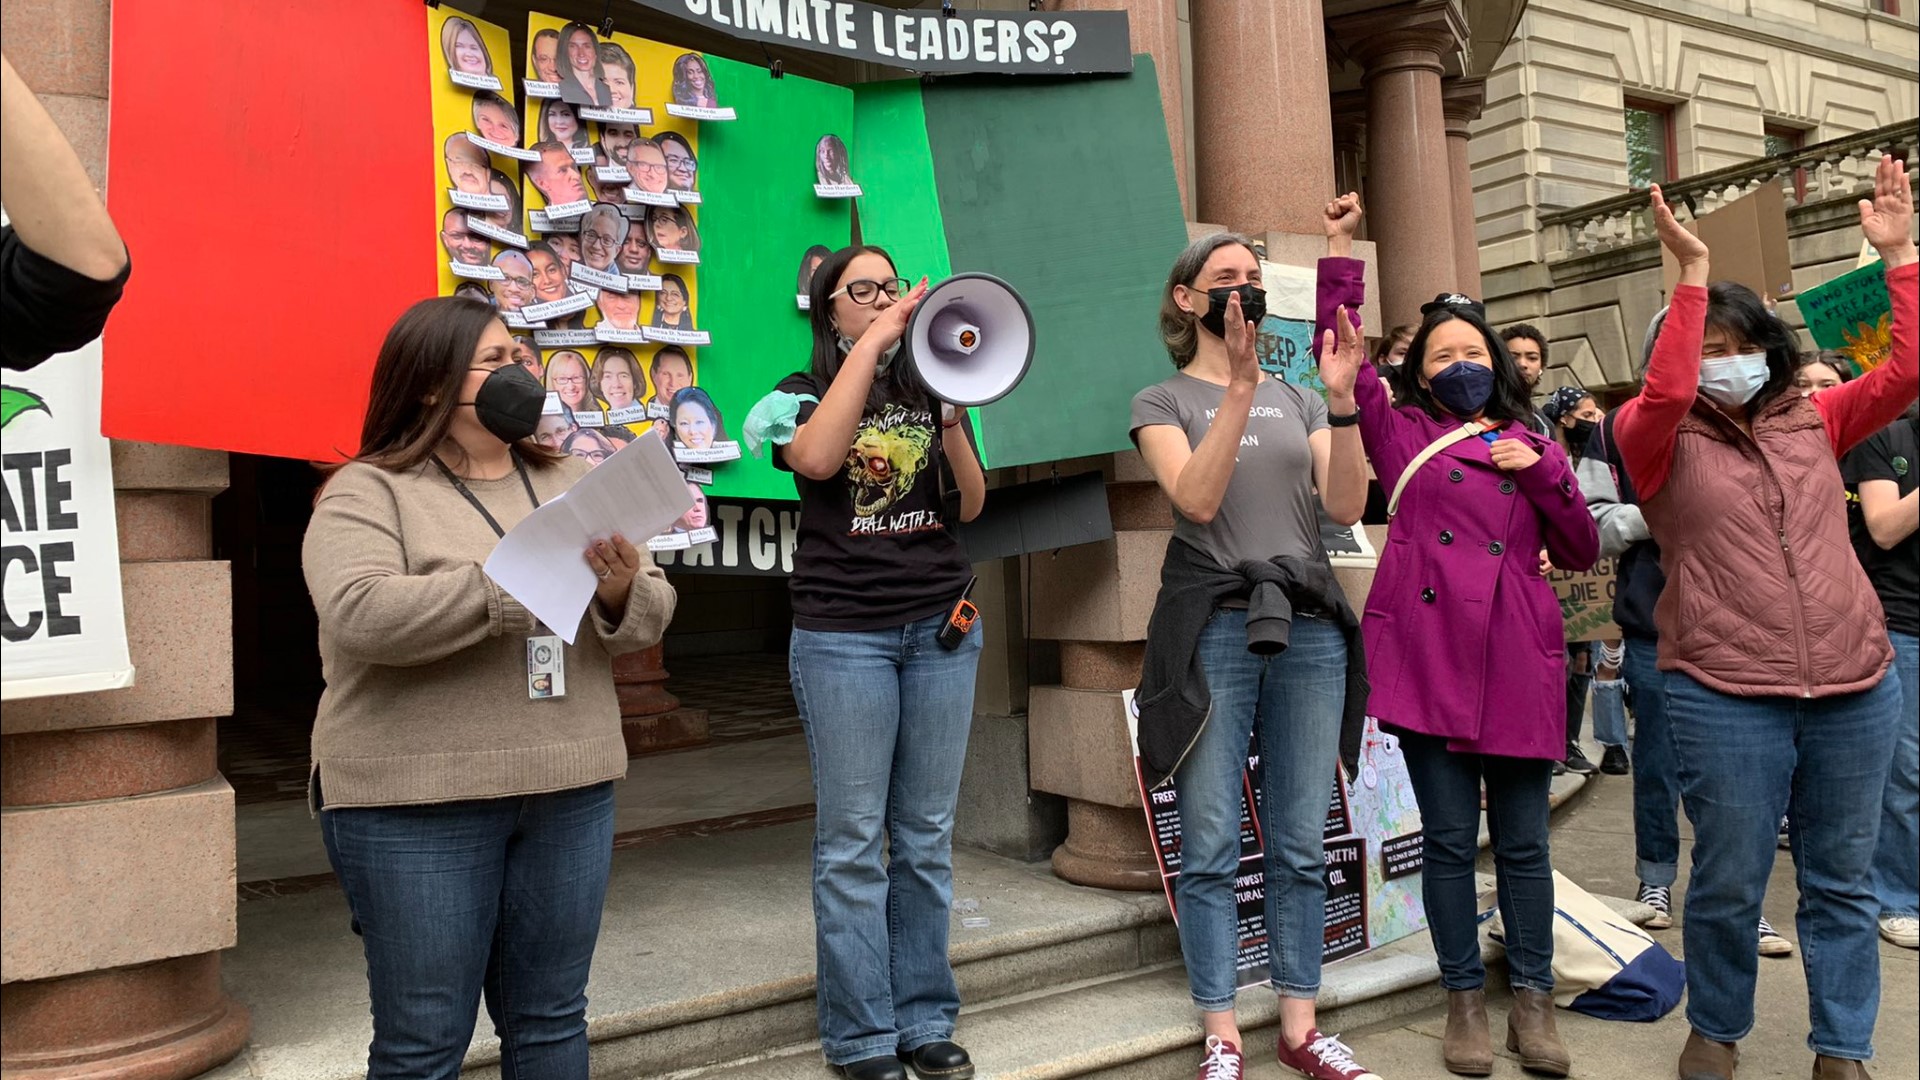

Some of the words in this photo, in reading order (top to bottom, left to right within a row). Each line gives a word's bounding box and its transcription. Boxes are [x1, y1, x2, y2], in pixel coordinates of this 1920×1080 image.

[872, 11, 1077, 65] LEADERS?
[526, 82, 551, 90] Michael
[548, 205, 560, 213] Ted
[561, 201, 588, 211] Wheeler
[580, 267, 594, 275] Tina
[595, 271, 613, 281] Kotek
[1257, 334, 1296, 368] EEP
[608, 411, 625, 419] Mary
[626, 408, 643, 416] Nolan
[1206, 406, 1284, 420] NBORS
[850, 514, 887, 535] DEAL
[890, 510, 925, 533] WITH
[656, 505, 801, 573] TCH
[1, 541, 82, 642] CE
[1570, 582, 1599, 601] DIE
[1324, 847, 1358, 865] ENITH
[1234, 872, 1264, 889] HWEST
[1329, 869, 1346, 886] OIL
